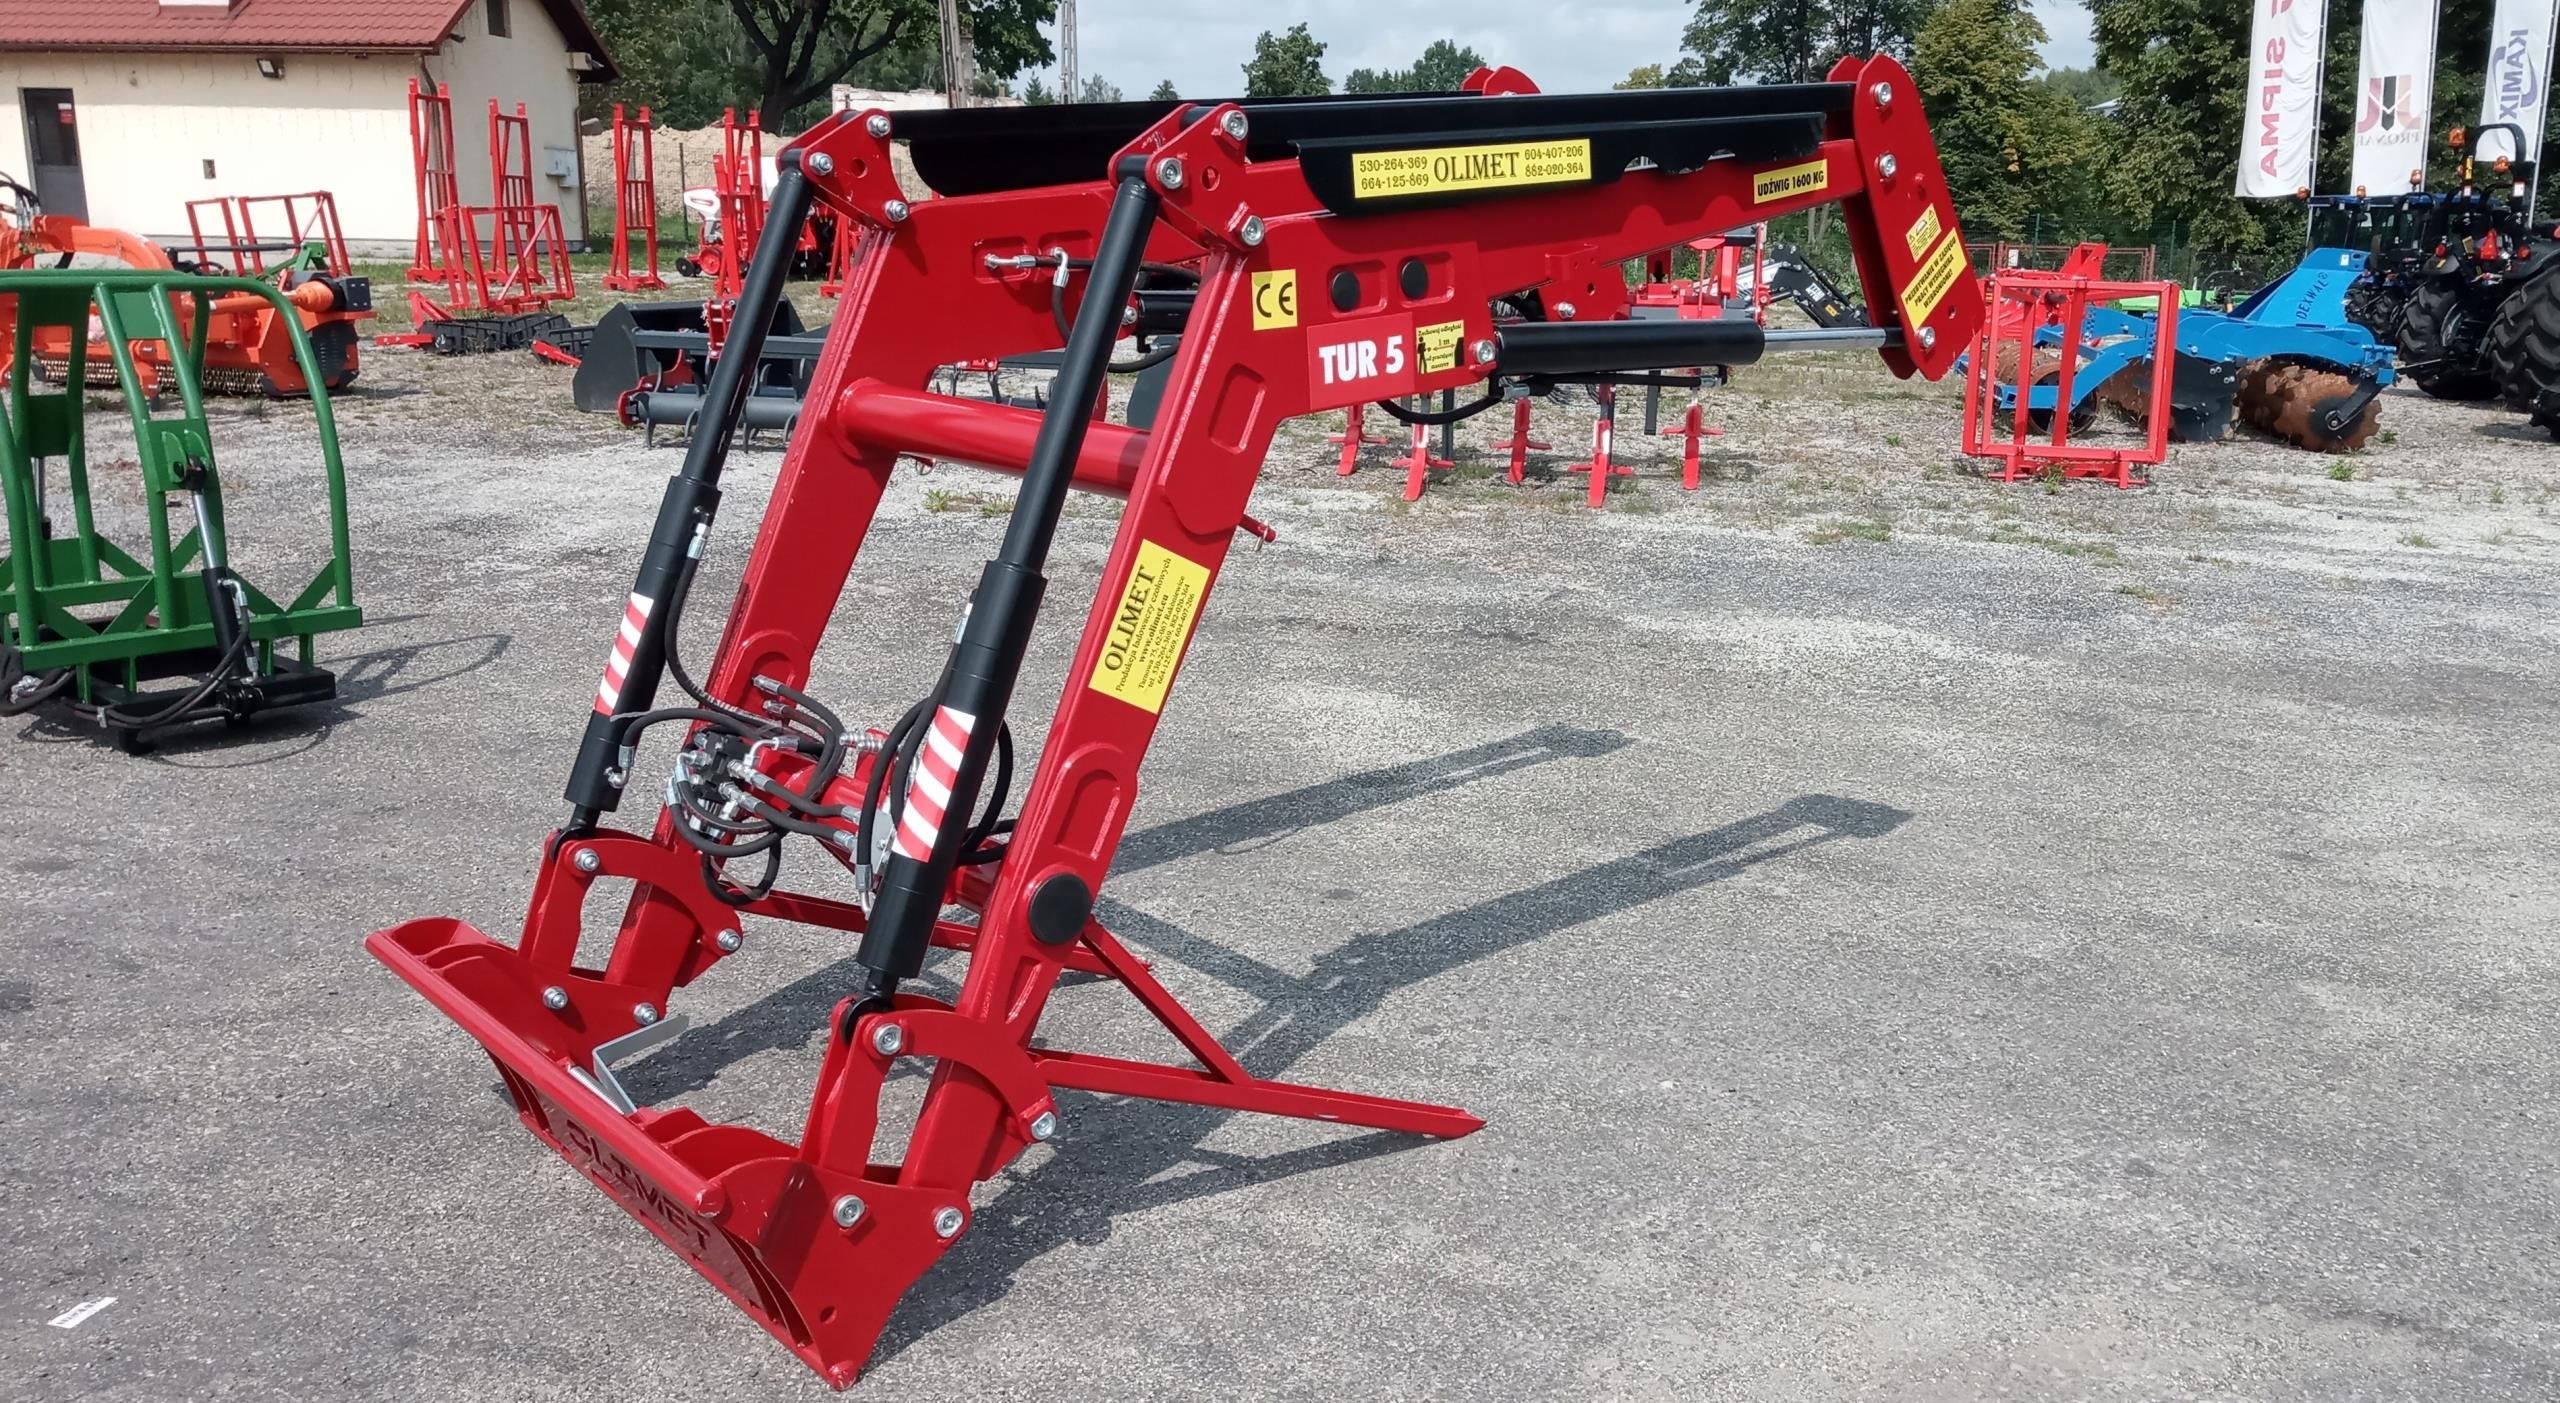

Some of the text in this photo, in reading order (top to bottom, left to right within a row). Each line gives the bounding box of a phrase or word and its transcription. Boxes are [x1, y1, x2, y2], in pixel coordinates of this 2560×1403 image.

[1360, 157, 1428, 172] 530-264-369
[1433, 152, 1520, 183] OLIMET
[1524, 146, 1583, 160] 604-407-206
[1362, 173, 1429, 190] 664-125-869
[1525, 162, 1584, 178] 882-020-364
[1792, 173, 1811, 188] 1600
[1813, 170, 1824, 184] KG
[1905, 267, 1934, 304] PRZEBYWANIE
[1933, 258, 1939, 267] W
[1915, 287, 1928, 306] PRACY
[1256, 282, 1294, 318] CE
[1318, 334, 1404, 384] TUR 5
[1104, 565, 1155, 670] OLIMET
[1139, 594, 1168, 662] www.olimet.eu
[1116, 652, 1137, 692] Produkcja
[1138, 660, 1154, 688] Tarnowa
[566, 1119, 710, 1250] OLIMET
